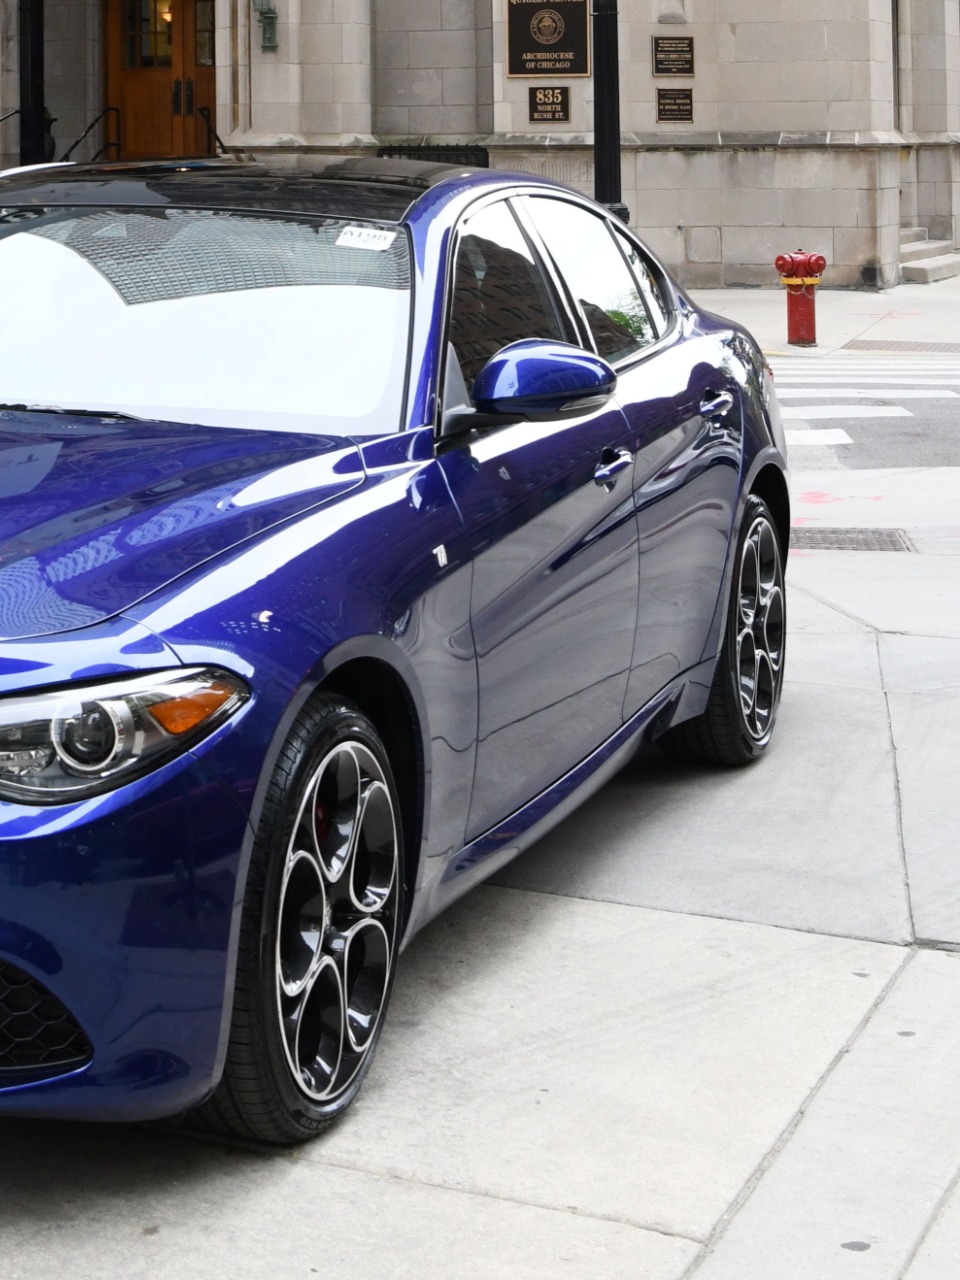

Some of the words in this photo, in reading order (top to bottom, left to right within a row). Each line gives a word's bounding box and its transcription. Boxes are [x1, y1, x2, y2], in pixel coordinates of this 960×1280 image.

[522, 52, 574, 60] ARCHDIOCESE
[537, 61, 571, 69] CHICAGO
[536, 89, 562, 104] 835
[537, 104, 562, 112] NORTH
